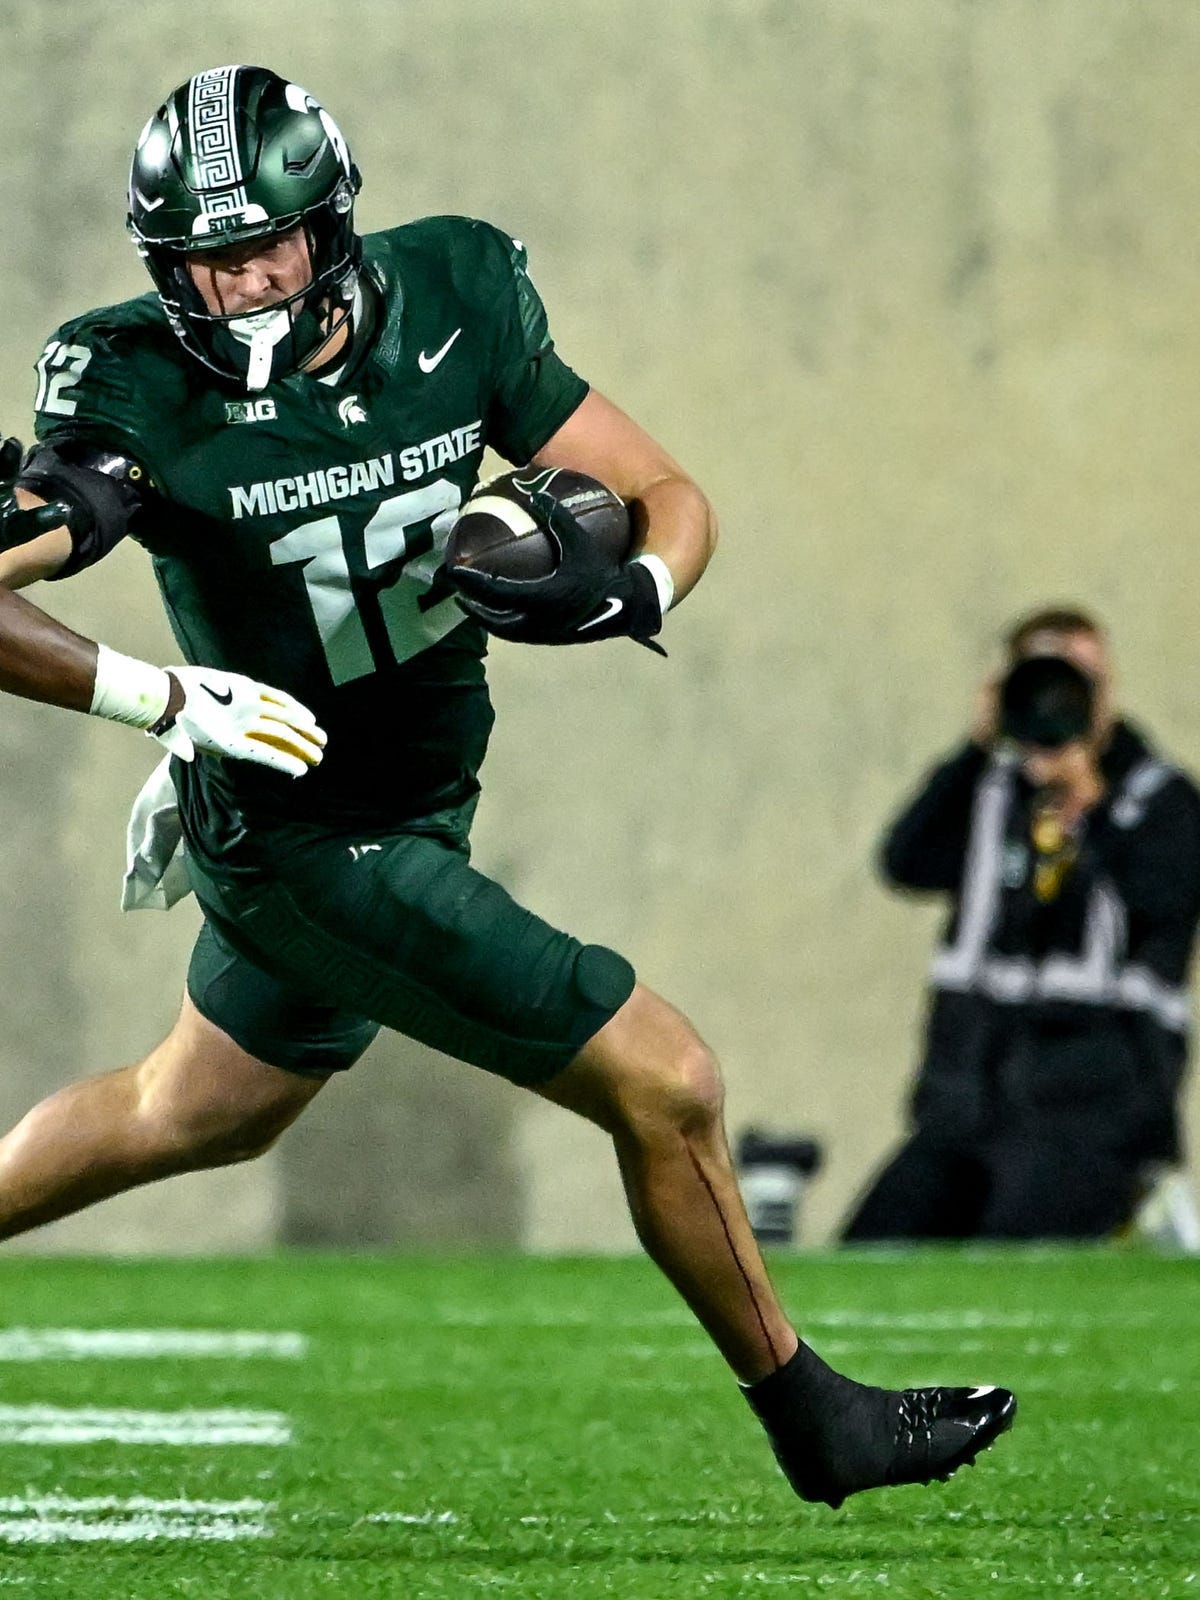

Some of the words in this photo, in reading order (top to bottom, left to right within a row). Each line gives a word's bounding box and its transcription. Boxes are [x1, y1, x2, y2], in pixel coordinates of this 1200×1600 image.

[208, 212, 246, 232] STATE
[35, 341, 92, 416] 12
[227, 453, 395, 520] MICHIGAN
[400, 419, 483, 482] STATE
[269, 478, 469, 687] 12
